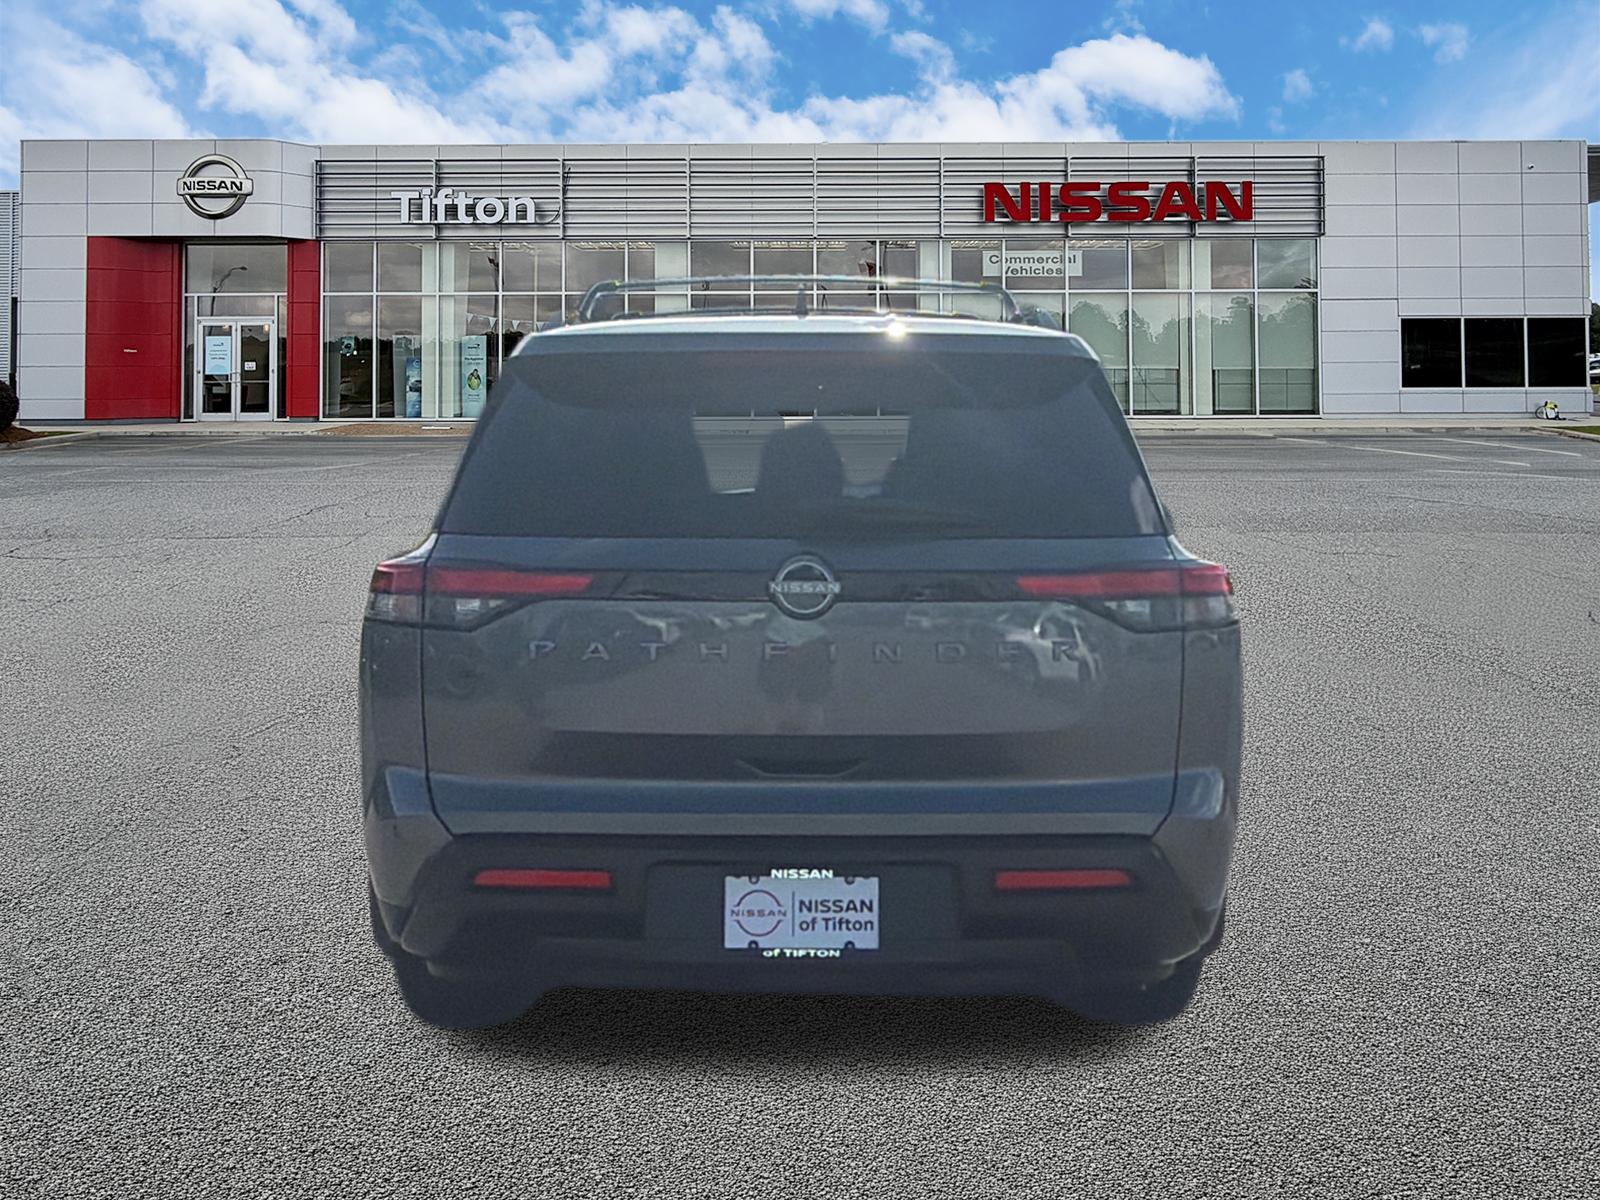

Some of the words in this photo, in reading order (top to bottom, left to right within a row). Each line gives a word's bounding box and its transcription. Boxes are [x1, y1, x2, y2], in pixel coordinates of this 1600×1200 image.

[183, 180, 243, 192] NISSAN
[391, 187, 536, 224] Tifton
[983, 181, 1253, 222] NISSAN
[769, 582, 840, 593] NISSAN
[529, 640, 1078, 662] PATHFINDER
[771, 869, 834, 879] NISSAN
[799, 900, 874, 913] NISSAN
[730, 909, 787, 917] NISSAN
[800, 918, 818, 932] of
[822, 917, 874, 932] Tifton
[762, 949, 780, 957] of
[783, 950, 841, 958] TIFTON
